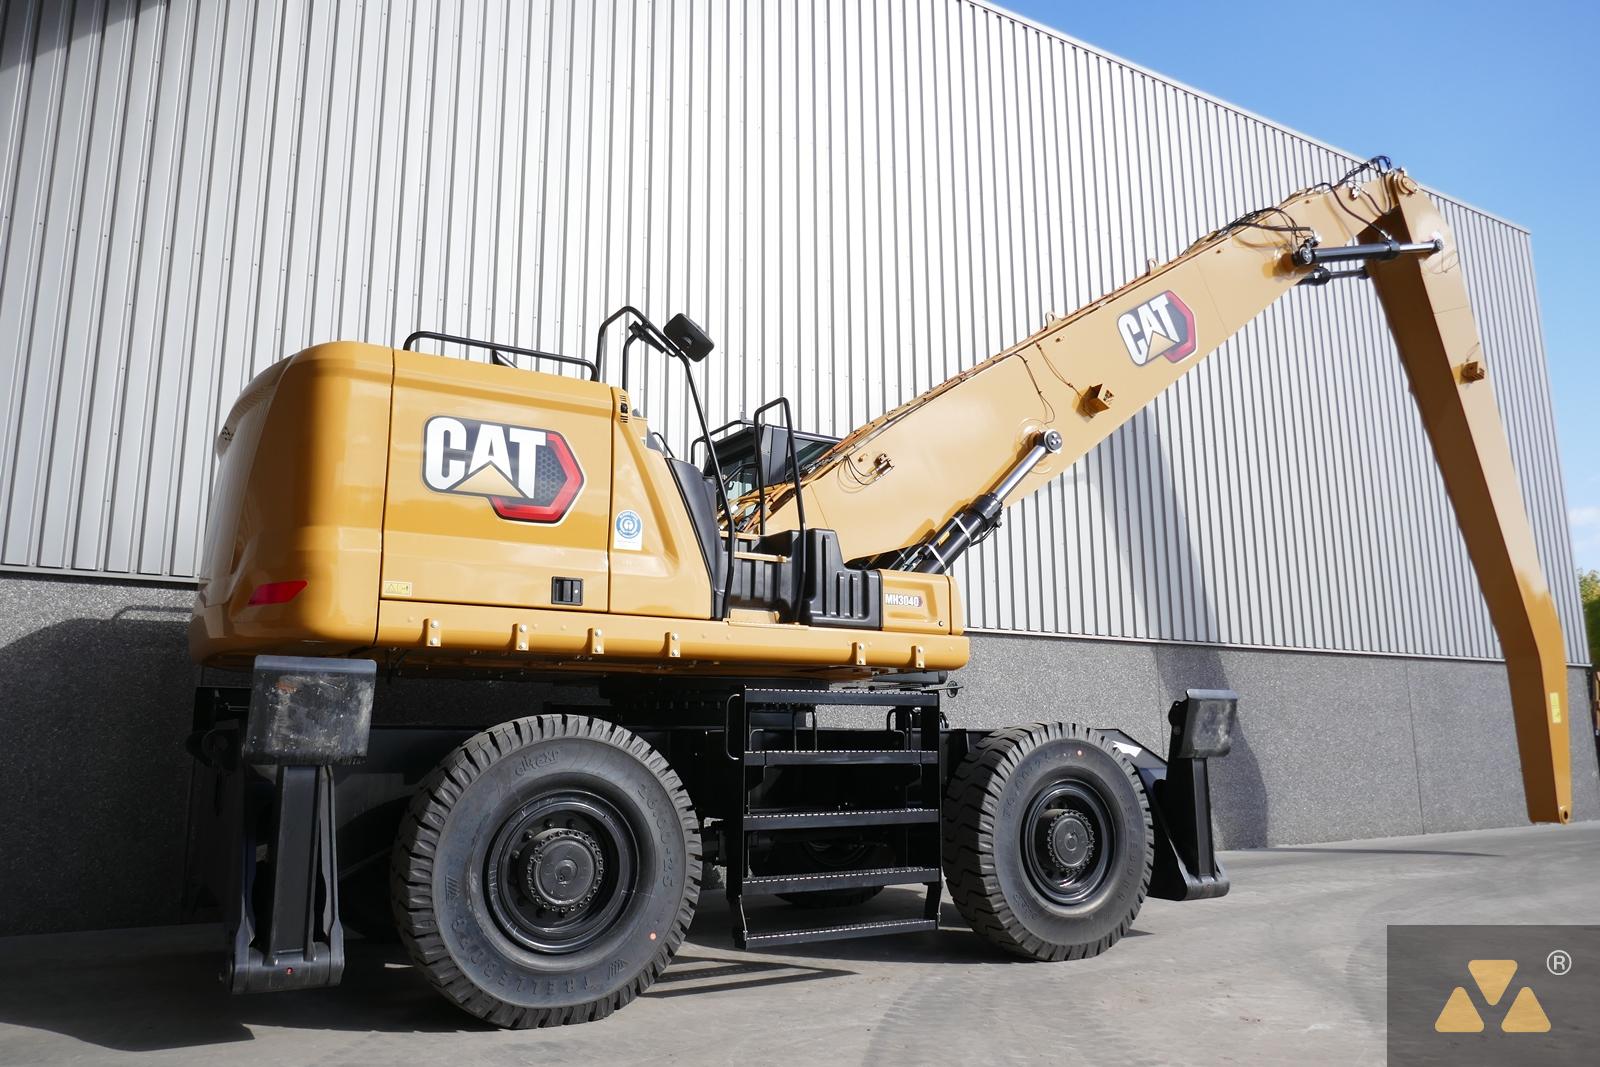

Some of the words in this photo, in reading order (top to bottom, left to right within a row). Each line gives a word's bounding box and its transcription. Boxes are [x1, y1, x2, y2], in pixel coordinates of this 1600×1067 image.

[1118, 294, 1180, 364] CAT
[425, 416, 546, 499] CAT
[885, 593, 919, 607] MH3040
